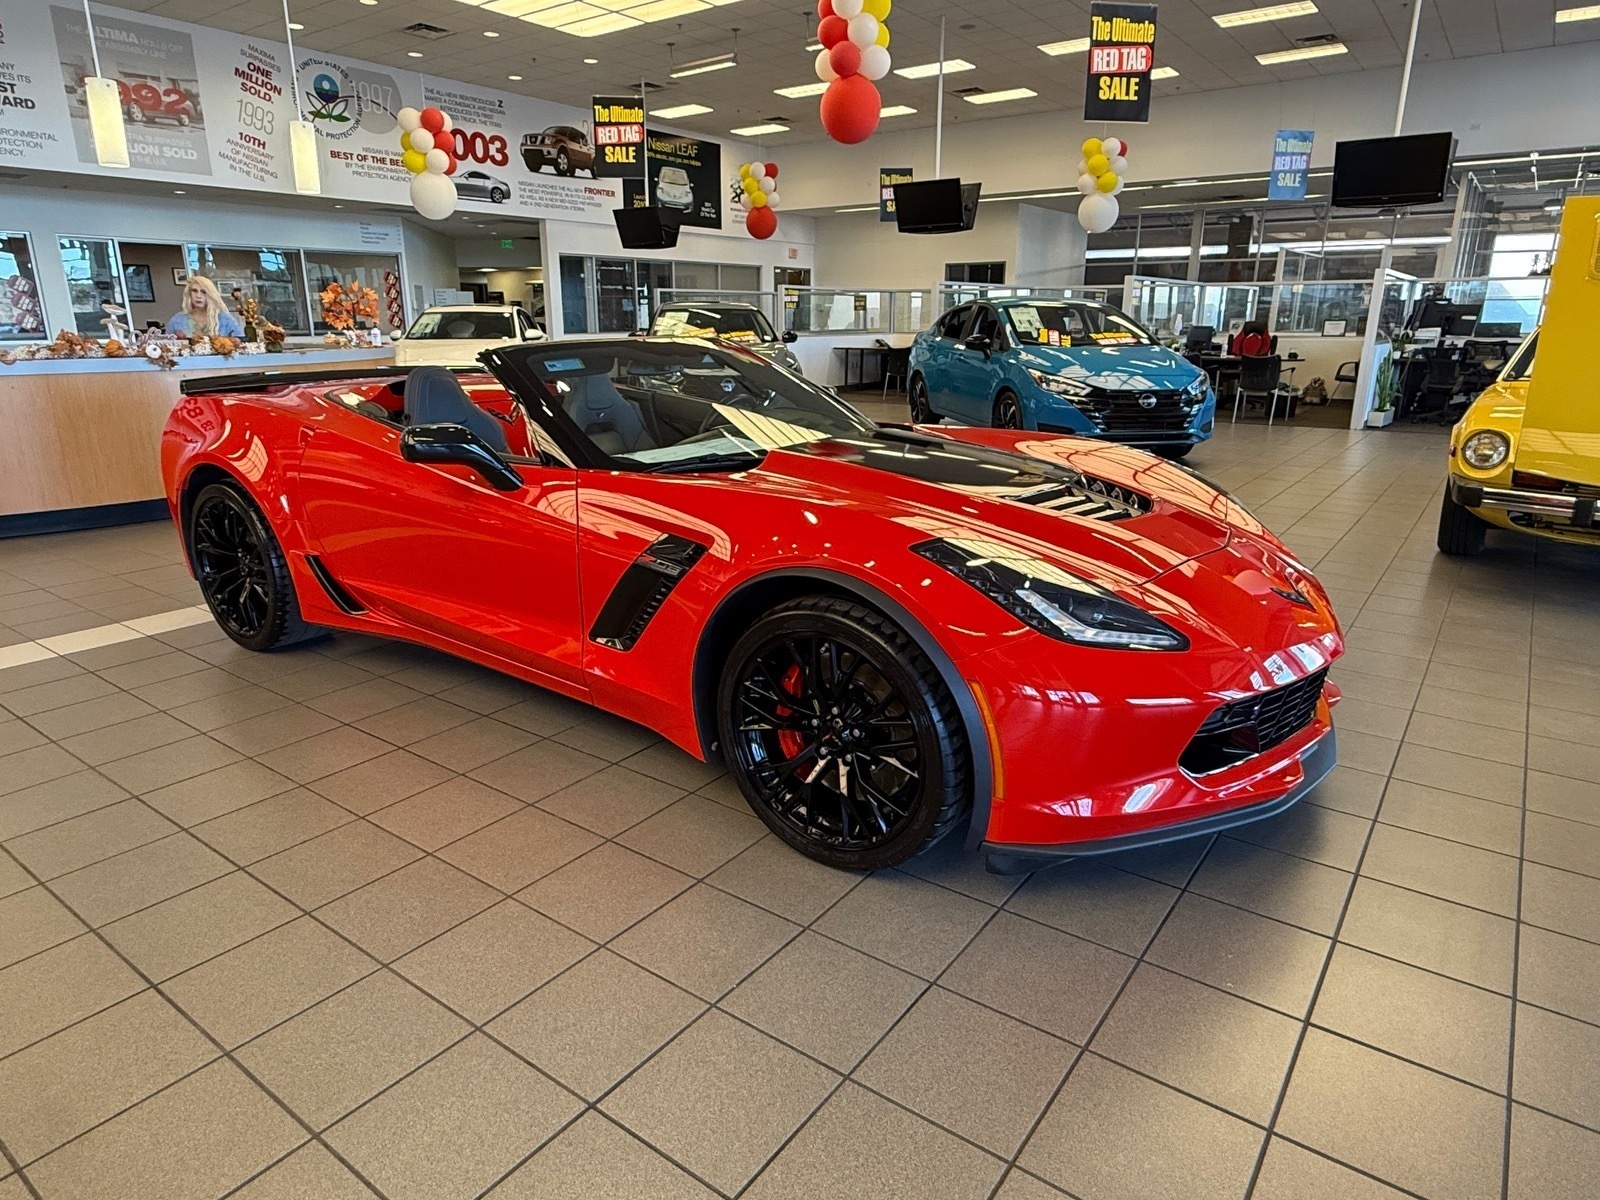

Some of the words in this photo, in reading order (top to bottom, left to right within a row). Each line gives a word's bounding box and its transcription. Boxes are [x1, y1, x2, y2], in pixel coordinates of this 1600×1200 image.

[86, 26, 139, 45] LTIMA
[1092, 16, 1111, 41] The
[1111, 17, 1155, 43] Ultimate
[240, 48, 282, 74] SURPASSES
[247, 43, 276, 63] MAXIMA
[1093, 48, 1119, 72] RED
[1120, 47, 1147, 71] TAG
[17, 74, 31, 84] ITS
[247, 61, 273, 81] ONE
[234, 66, 282, 96] MILLION
[1098, 75, 1139, 101] SALE
[240, 81, 274, 104] SOLD.
[349, 80, 393, 115] 1997
[0, 95, 36, 110] ARD
[497, 99, 503, 108] Z
[237, 98, 275, 135] 1993
[593, 105, 609, 123] The
[610, 105, 643, 123] Ultimate
[238, 131, 267, 150] 10TH
[598, 126, 619, 144] RED
[619, 125, 640, 143] TAG
[163, 147, 197, 160] SOLD
[226, 138, 275, 161] ANNIVERSARY
[362, 146, 384, 155] NISSAN
[450, 128, 509, 167] 003
[604, 145, 637, 163] SALE
[648, 136, 675, 154] Nissan
[676, 142, 699, 158] LEAF
[1276, 138, 1287, 153] The
[218, 151, 278, 179] MANUFACTURING
[230, 147, 241, 156] OF
[242, 152, 269, 168] NISSAN
[329, 149, 354, 161] BEST
[356, 153, 369, 163] OF
[370, 155, 388, 166] THE
[389, 158, 405, 168] BES
[354, 162, 366, 170] THE
[1275, 156, 1291, 171] RED
[1291, 155, 1307, 170] TAG
[239, 166, 252, 178] THE
[352, 170, 388, 180] PROTECTION
[1277, 172, 1302, 187] SALE
[583, 186, 616, 198] FRONTIER
